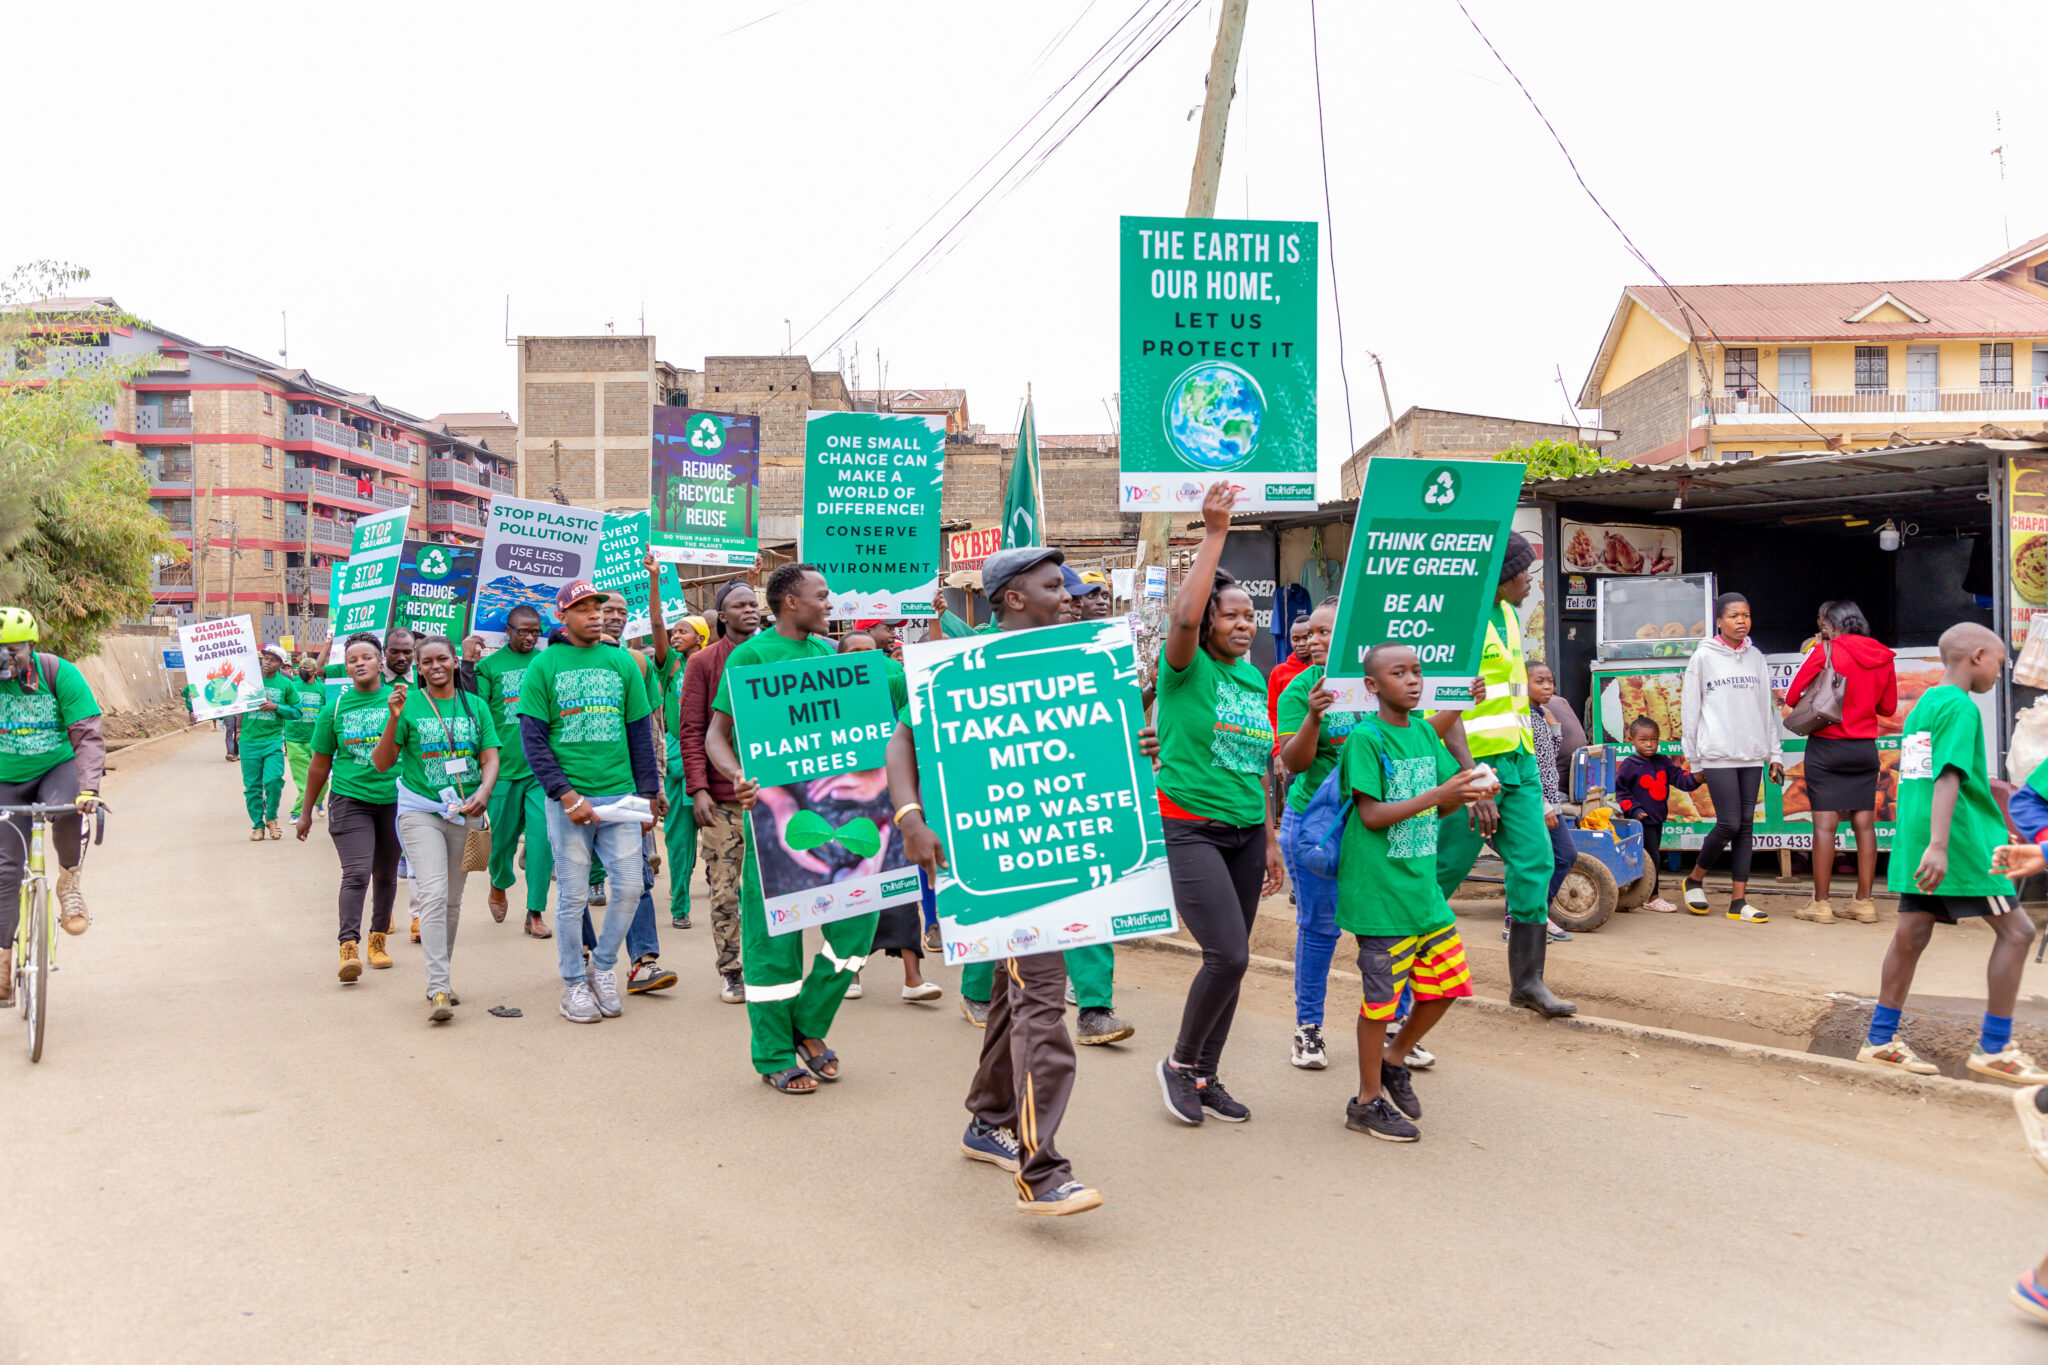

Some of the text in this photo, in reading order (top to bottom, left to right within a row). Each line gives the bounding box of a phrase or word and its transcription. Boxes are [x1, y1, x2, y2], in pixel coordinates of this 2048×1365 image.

[1139, 230, 1300, 263] THE EARTH IS
[1151, 269, 1281, 304] OUR HOME,
[1175, 312, 1262, 330] LET US
[1143, 340, 1294, 358] PROTECT IT
[826, 436, 920, 450] ONE SMALL
[818, 452, 928, 467] CHANGE CAN
[682, 460, 732, 481] REDUCE
[838, 470, 902, 482] MAKE A
[678, 484, 734, 504] RECYCLE
[828, 486, 915, 499] WORLD OF
[1266, 486, 1312, 496] ChildFund
[686, 508, 727, 527] REUSE
[817, 502, 924, 516] DIFFERENCE!
[494, 506, 599, 532] STOP PLASTIC
[363, 521, 392, 540] STOP
[499, 522, 588, 545] POLLUTION!
[600, 523, 638, 541] EVERY
[826, 526, 917, 537] CONSERVE
[360, 536, 391, 549] CHILD LABOUR
[602, 536, 639, 552] CHILD
[856, 544, 887, 555] THE
[951, 528, 1002, 560] CYBER
[1367, 532, 1493, 552] THINK GREEN
[510, 546, 564, 563] USE LESS
[604, 547, 643, 564] HAS A
[355, 563, 383, 581] STOP
[508, 560, 564, 576] PLASTIC!
[594, 562, 631, 579] RIGHT
[810, 562, 935, 574] NVIRONMENT.
[951, 560, 975, 572] INSTANT
[1366, 557, 1479, 576] LIVE GREEN.
[351, 578, 382, 590] CHILD LABOUR
[595, 565, 668, 590] CHILDHOD
[635, 576, 669, 592] FRM
[412, 583, 456, 600] REDUCE
[406, 602, 456, 619] RECYCLE
[1384, 594, 1444, 613] BE AN
[1567, 598, 1579, 608] Tel
[347, 605, 375, 623] STOP
[194, 620, 237, 634] GLOBAL
[344, 619, 374, 631] CHILD LABOUR
[412, 621, 447, 637] REUSE
[1386, 620, 1434, 638] ECO-
[190, 628, 244, 643] WARMING,
[194, 646, 247, 662] WARNING!
[198, 639, 241, 652] GLOBAL
[1358, 644, 1456, 663] WIOR!
[746, 664, 870, 700] TUPANDE
[947, 672, 1097, 712] TUSITUPE
[1436, 687, 1469, 697] ChildFun
[557, 697, 620, 709] YOUTHFUL
[560, 708, 582, 716] AND
[788, 699, 840, 726] MITI
[941, 701, 1113, 744] TAKA KWA
[1213, 721, 1242, 733] AND
[750, 722, 892, 759] PLANT MORE
[1330, 736, 1346, 744] AN
[989, 739, 1075, 770] MITO.
[787, 751, 858, 777] TREES
[987, 772, 1086, 802] DO NOT
[956, 790, 1134, 830] DUMP WASTE
[982, 816, 1113, 850] IN WATER
[1752, 836, 1782, 848] 0703
[998, 843, 1105, 872] BODIES.
[882, 880, 917, 892] ChildFund
[1113, 912, 1167, 929] ChildFund
